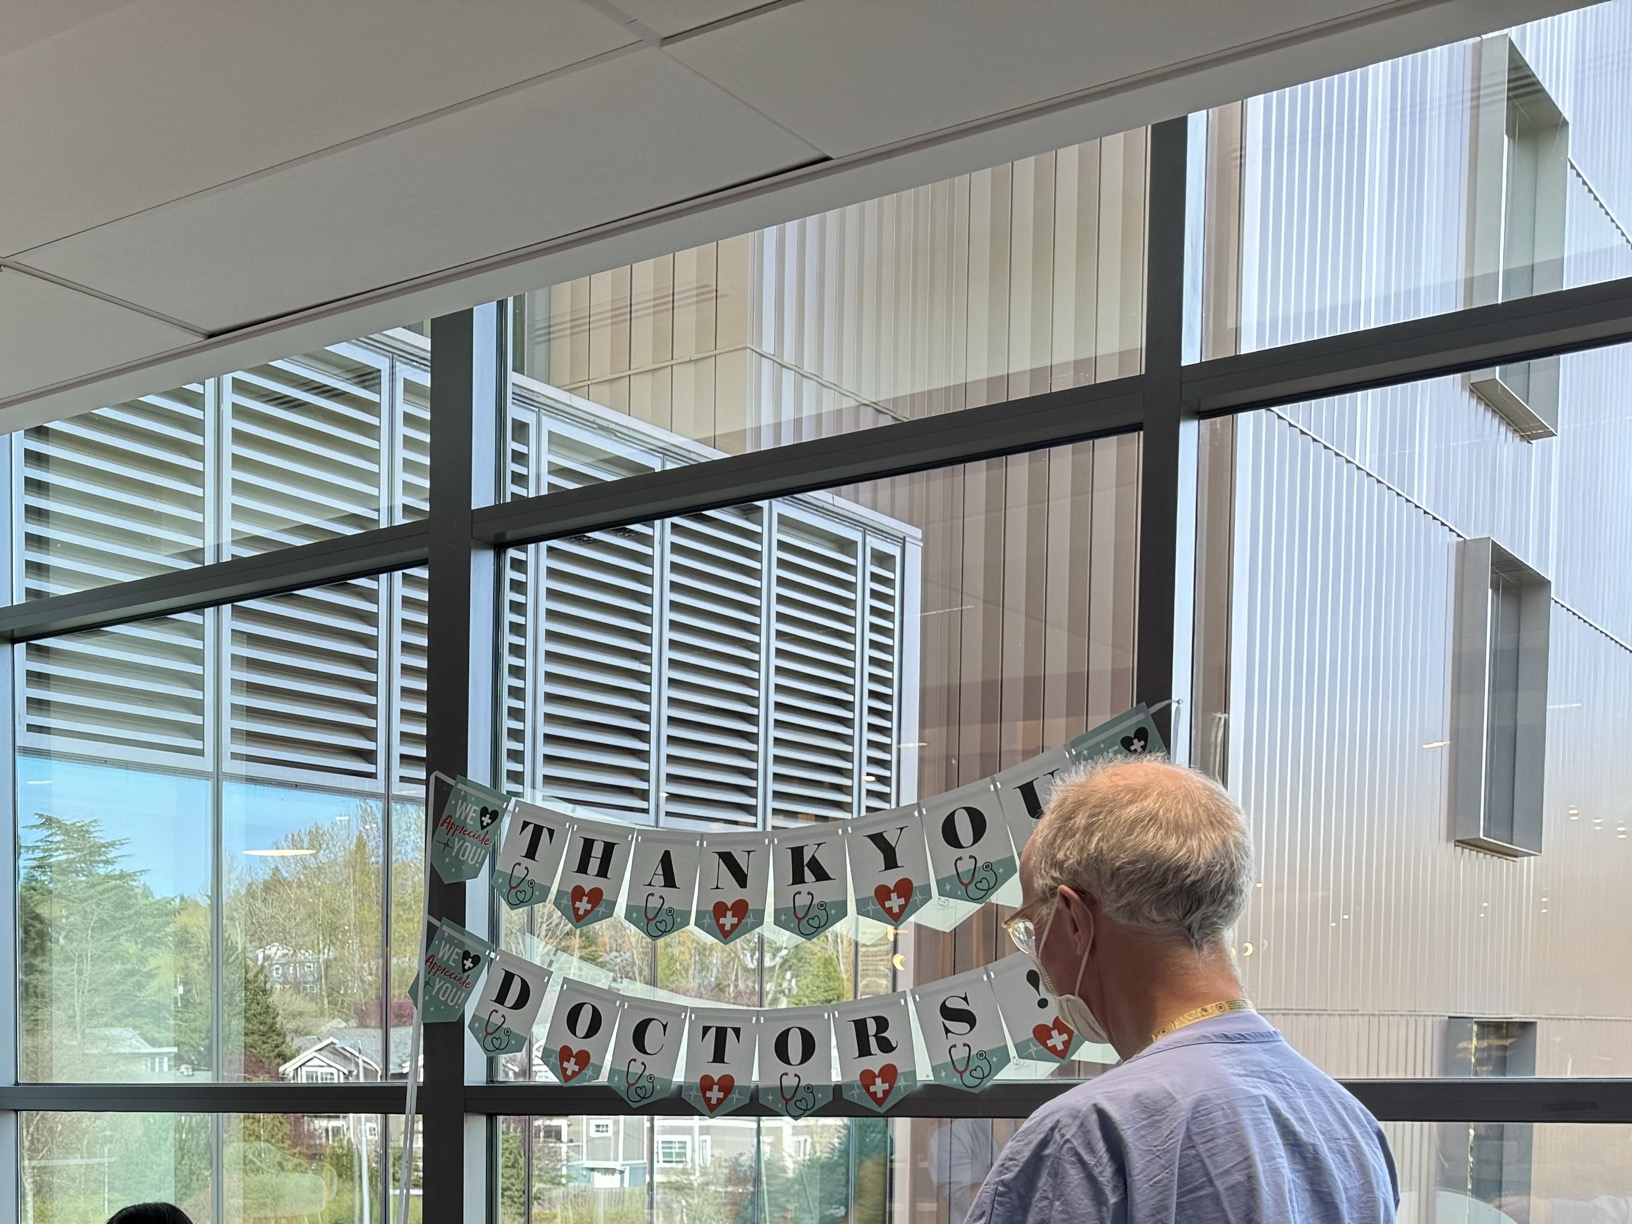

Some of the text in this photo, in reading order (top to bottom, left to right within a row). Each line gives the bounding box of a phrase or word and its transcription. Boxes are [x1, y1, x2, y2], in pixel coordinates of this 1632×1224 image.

[455, 799, 479, 825] WE
[440, 814, 492, 846] Appreciate
[451, 837, 486, 867] YOU!
[438, 940, 462, 967] WE
[431, 976, 466, 1009] YOU!
